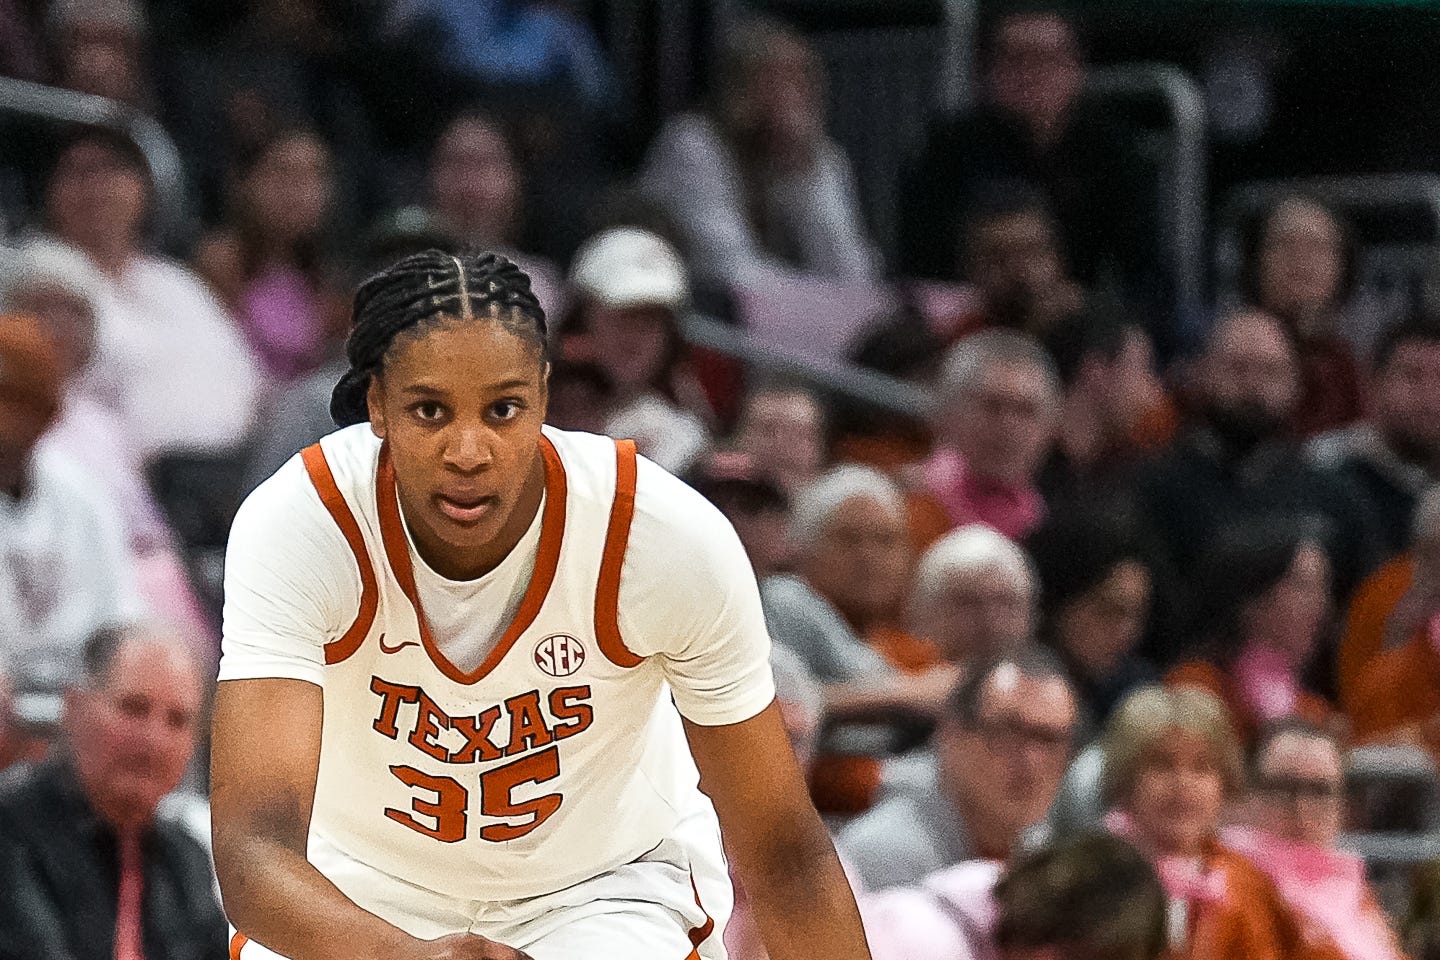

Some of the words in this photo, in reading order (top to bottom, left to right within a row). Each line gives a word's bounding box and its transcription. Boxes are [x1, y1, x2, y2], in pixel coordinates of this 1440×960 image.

[535, 636, 585, 677] SEC
[370, 675, 594, 764] TEXAS
[384, 745, 564, 843] 35
